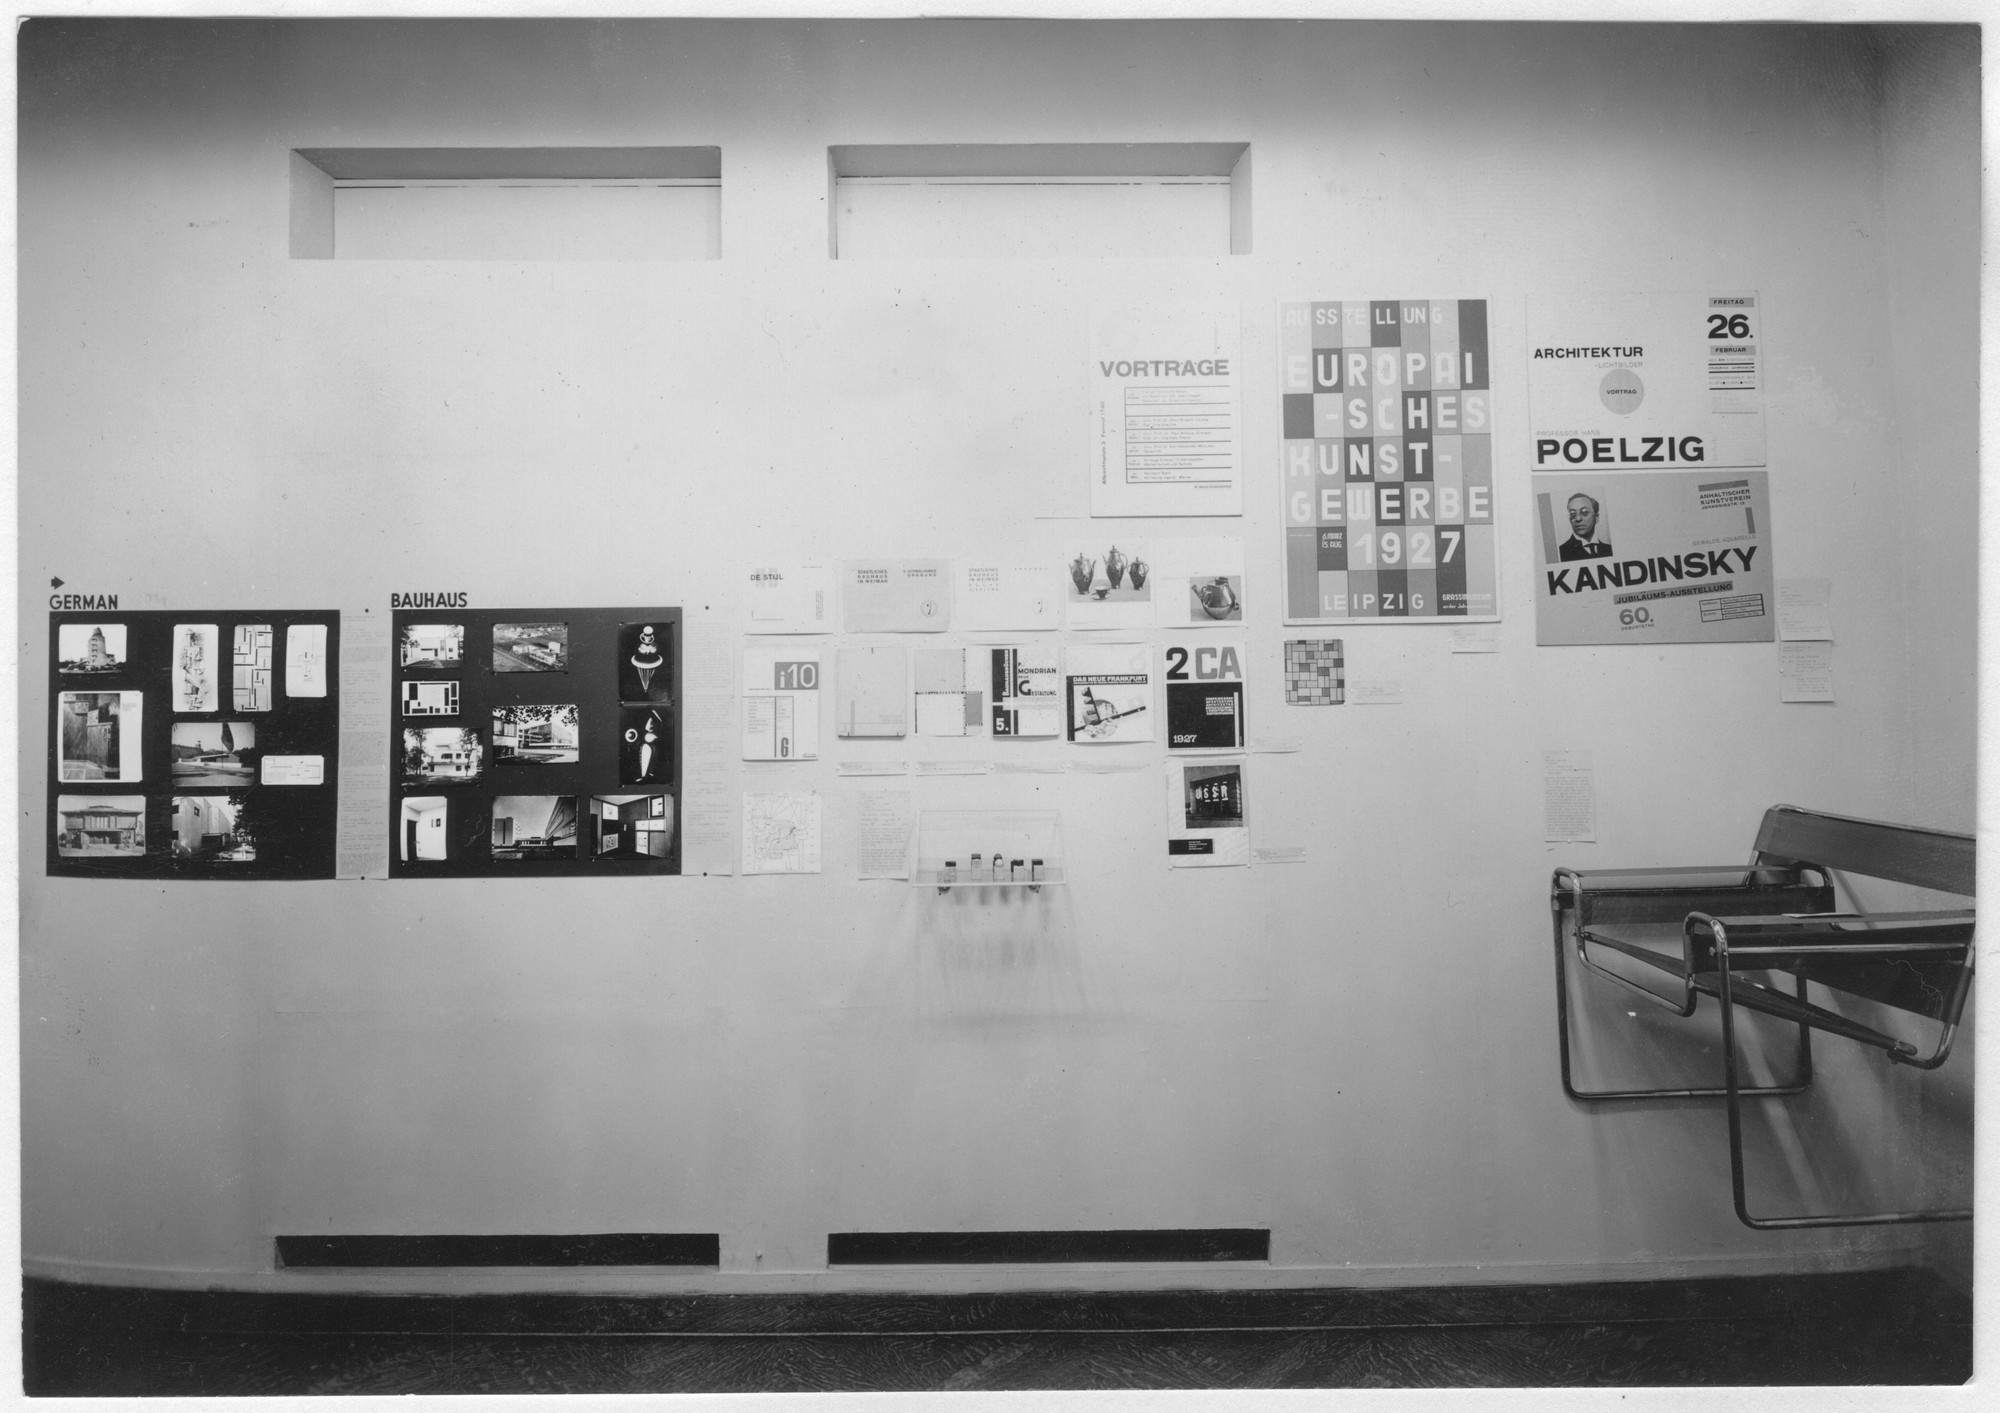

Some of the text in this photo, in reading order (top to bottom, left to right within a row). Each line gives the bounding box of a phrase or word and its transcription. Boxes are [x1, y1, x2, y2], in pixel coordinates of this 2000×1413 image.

[1706, 313, 1754, 339] 26.
[1534, 346, 1644, 360] ARCHITEKTUR
[1536, 436, 1705, 465] POELZIG
[1700, 488, 1751, 499] ANHALTISCHER
[1700, 495, 1751, 506] KUNSTVEREIN
[1291, 486, 1489, 522] GEWERBE
[1353, 531, 1461, 564] 1927
[1546, 546, 1758, 596] KANDINSKY
[49, 594, 118, 610] GERMAN
[391, 592, 468, 608] BAUHAUS
[1323, 593, 1424, 611] LEIPZIG
[1619, 606, 1654, 625] 60.
[1165, 646, 1243, 680] 2 CA
[780, 664, 816, 688] i10
[1018, 680, 1057, 696] GESTALTUNG
[996, 717, 1009, 731] 5.
[780, 736, 790, 758] 6
[1173, 734, 1197, 743] 1927
